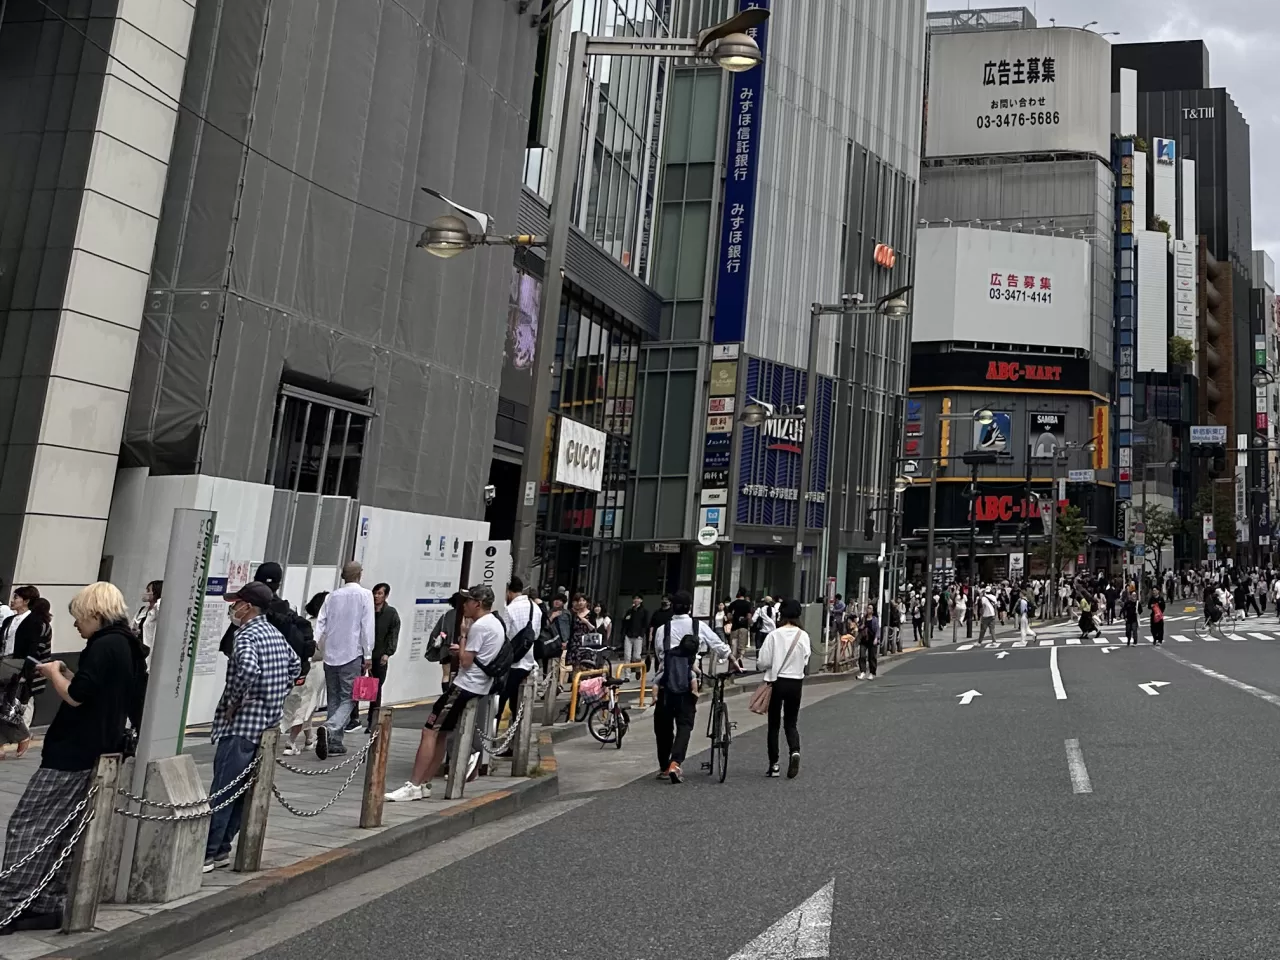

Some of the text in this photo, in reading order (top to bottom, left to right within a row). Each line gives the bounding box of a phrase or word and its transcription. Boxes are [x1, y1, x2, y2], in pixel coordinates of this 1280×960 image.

[983, 56, 1056, 87] 広告主募集
[990, 97, 1046, 109] お問い合わせ
[734, 87, 754, 181] みずほ信託銀行
[976, 111, 1061, 130] 03-3476-5686
[726, 203, 745, 273] みずほ銀行
[990, 273, 1052, 290] 広告募集
[989, 288, 1052, 304] 03-3471-4141
[986, 361, 1062, 381] ABC-MART
[764, 416, 806, 443] MIZUH
[1036, 415, 1059, 425] SAMBA
[566, 439, 601, 478] GUCCI
[198, 518, 214, 571] Clean
[187, 576, 207, 658] Shinjuku
